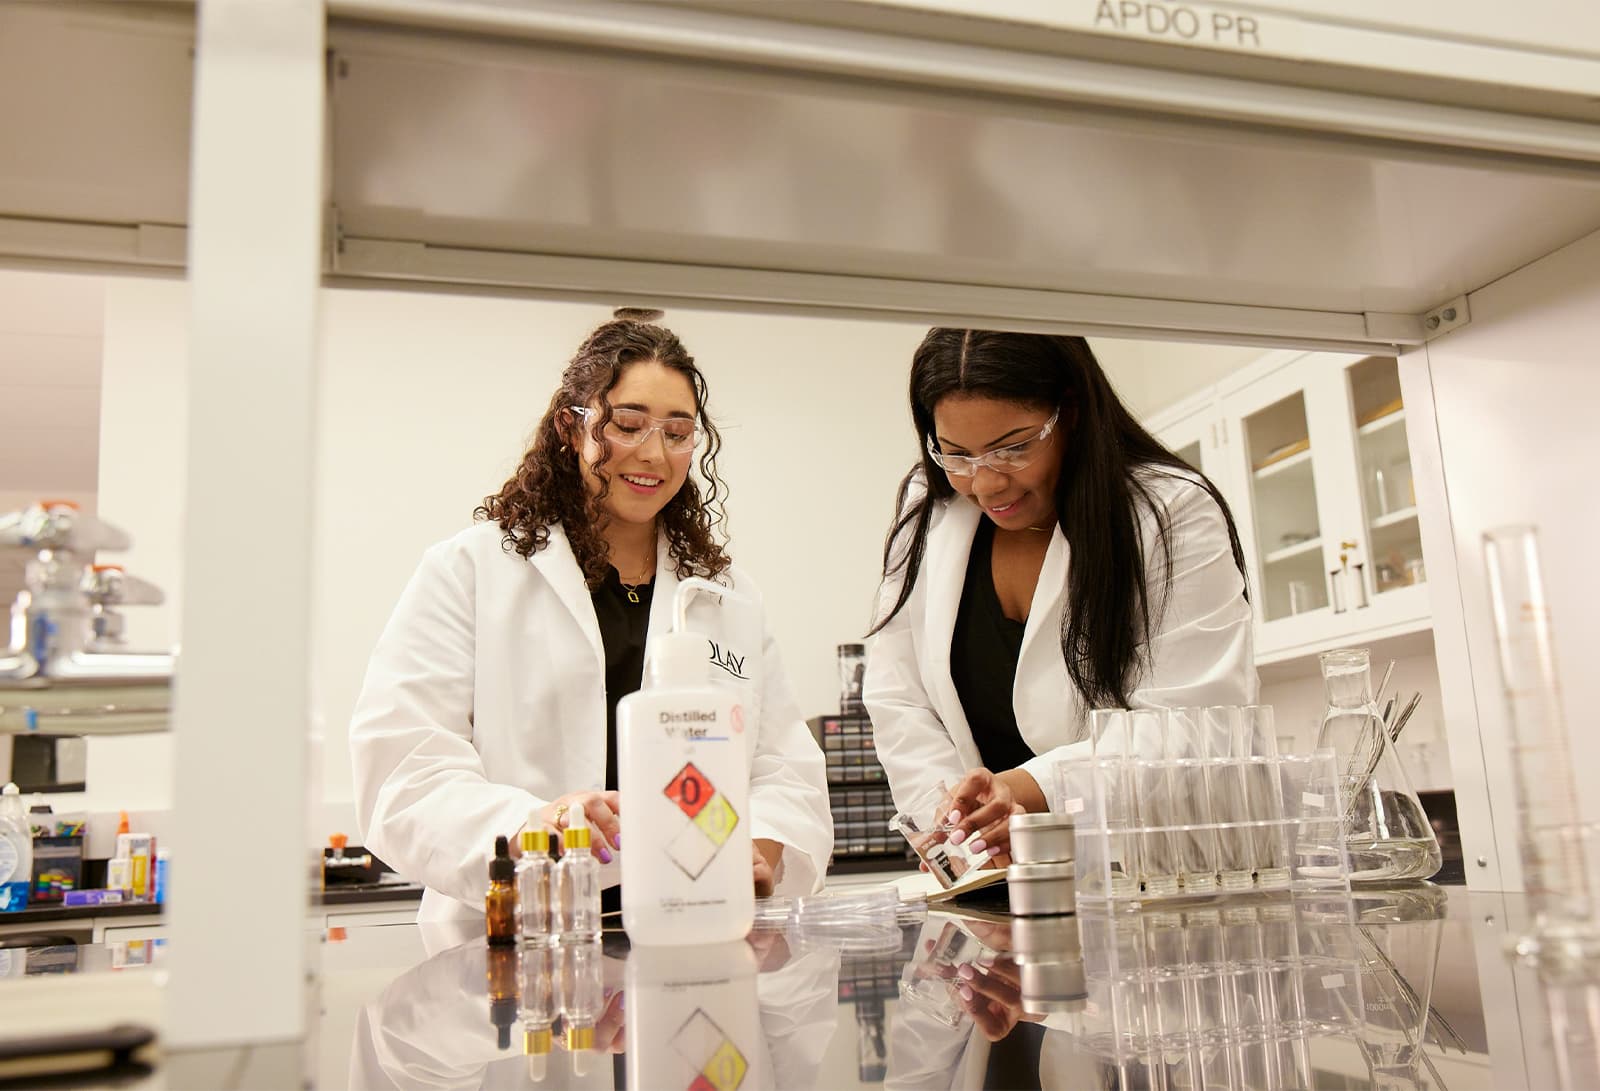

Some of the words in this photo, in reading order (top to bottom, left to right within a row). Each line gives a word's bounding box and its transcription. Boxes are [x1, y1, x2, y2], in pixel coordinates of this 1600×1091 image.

[1094, 0, 1200, 39] APDO
[1210, 13, 1261, 46] PR
[659, 711, 717, 724] Distilled
[665, 727, 707, 739] Wter
[681, 777, 700, 805] 0
[710, 804, 726, 833] 0
